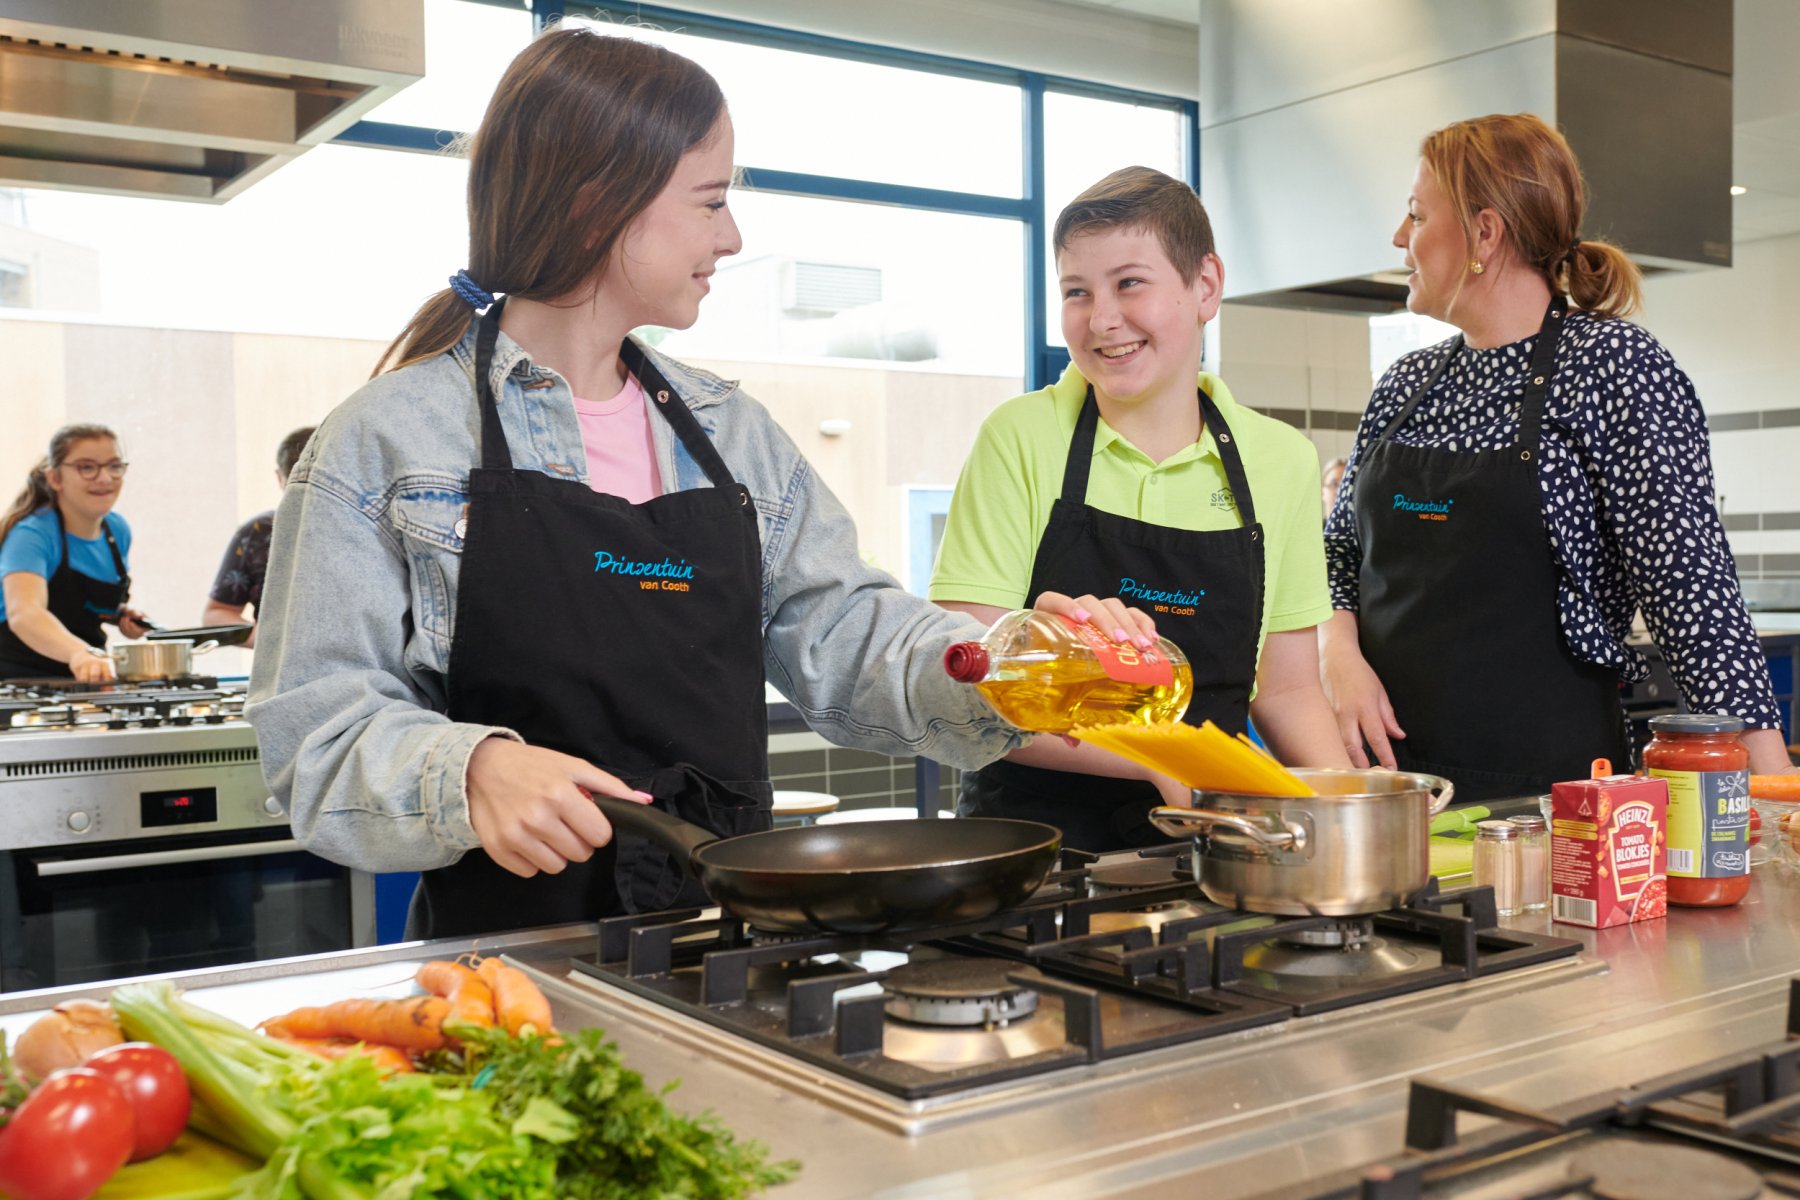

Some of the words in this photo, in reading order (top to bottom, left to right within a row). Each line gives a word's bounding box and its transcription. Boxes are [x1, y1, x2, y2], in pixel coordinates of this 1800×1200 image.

[594, 551, 695, 579] Prinsentuin
[640, 581, 659, 590] van
[661, 580, 690, 592] Cooth
[1119, 577, 1200, 606] Prinsentuin
[1154, 604, 1169, 613] van
[1171, 606, 1196, 616] Cooth
[1618, 807, 1650, 828] HEINZ
[1621, 834, 1645, 847] TOMATO
[1615, 843, 1650, 863] BLOKJES
